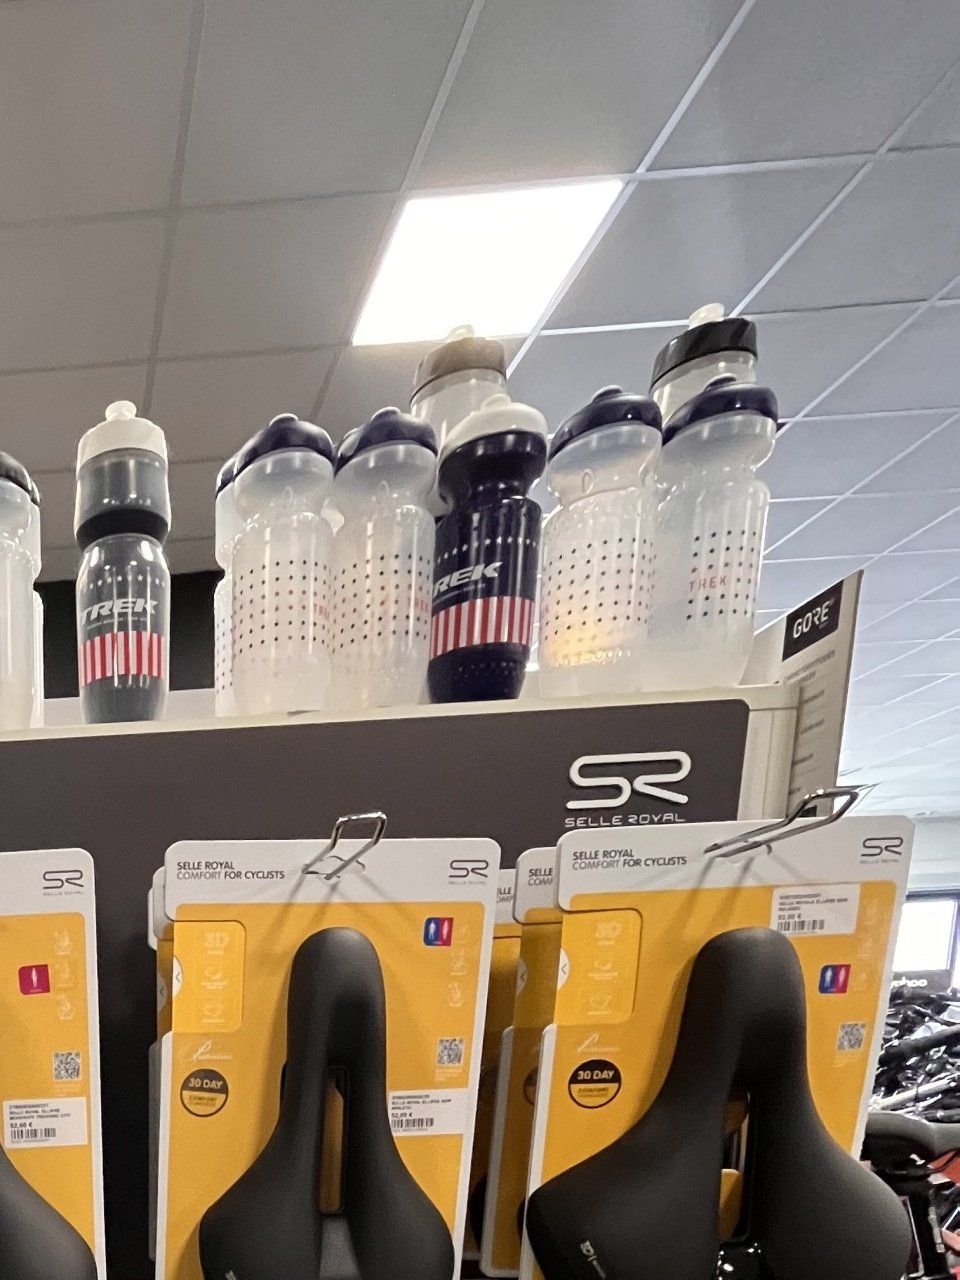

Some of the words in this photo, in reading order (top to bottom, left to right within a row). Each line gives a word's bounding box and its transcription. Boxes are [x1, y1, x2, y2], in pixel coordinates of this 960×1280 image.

[432, 561, 502, 598] REK
[690, 575, 727, 591] TREK
[80, 598, 158, 626] TREK
[793, 600, 829, 638] GORE
[565, 814, 623, 829] SELLE
[628, 811, 687, 826] ROYAL
[572, 850, 600, 861] SELLE
[602, 847, 635, 858] ROYAL
[177, 861, 202, 871] SELLE
[204, 860, 235, 870] ROYAL
[572, 859, 622, 870] COMFORT
[623, 858, 643, 868] FOR
[643, 855, 688, 867] CYCLISTS
[176, 871, 223, 881] COMFORT
[224, 871, 243, 880] FOR
[244, 870, 286, 880] CYCLISTS
[528, 867, 553, 878] SELLE
[577, 1071, 592, 1080] 30
[593, 1070, 616, 1080] DAY
[188, 1078, 202, 1088] 30
[203, 1079, 224, 1089] DAY
